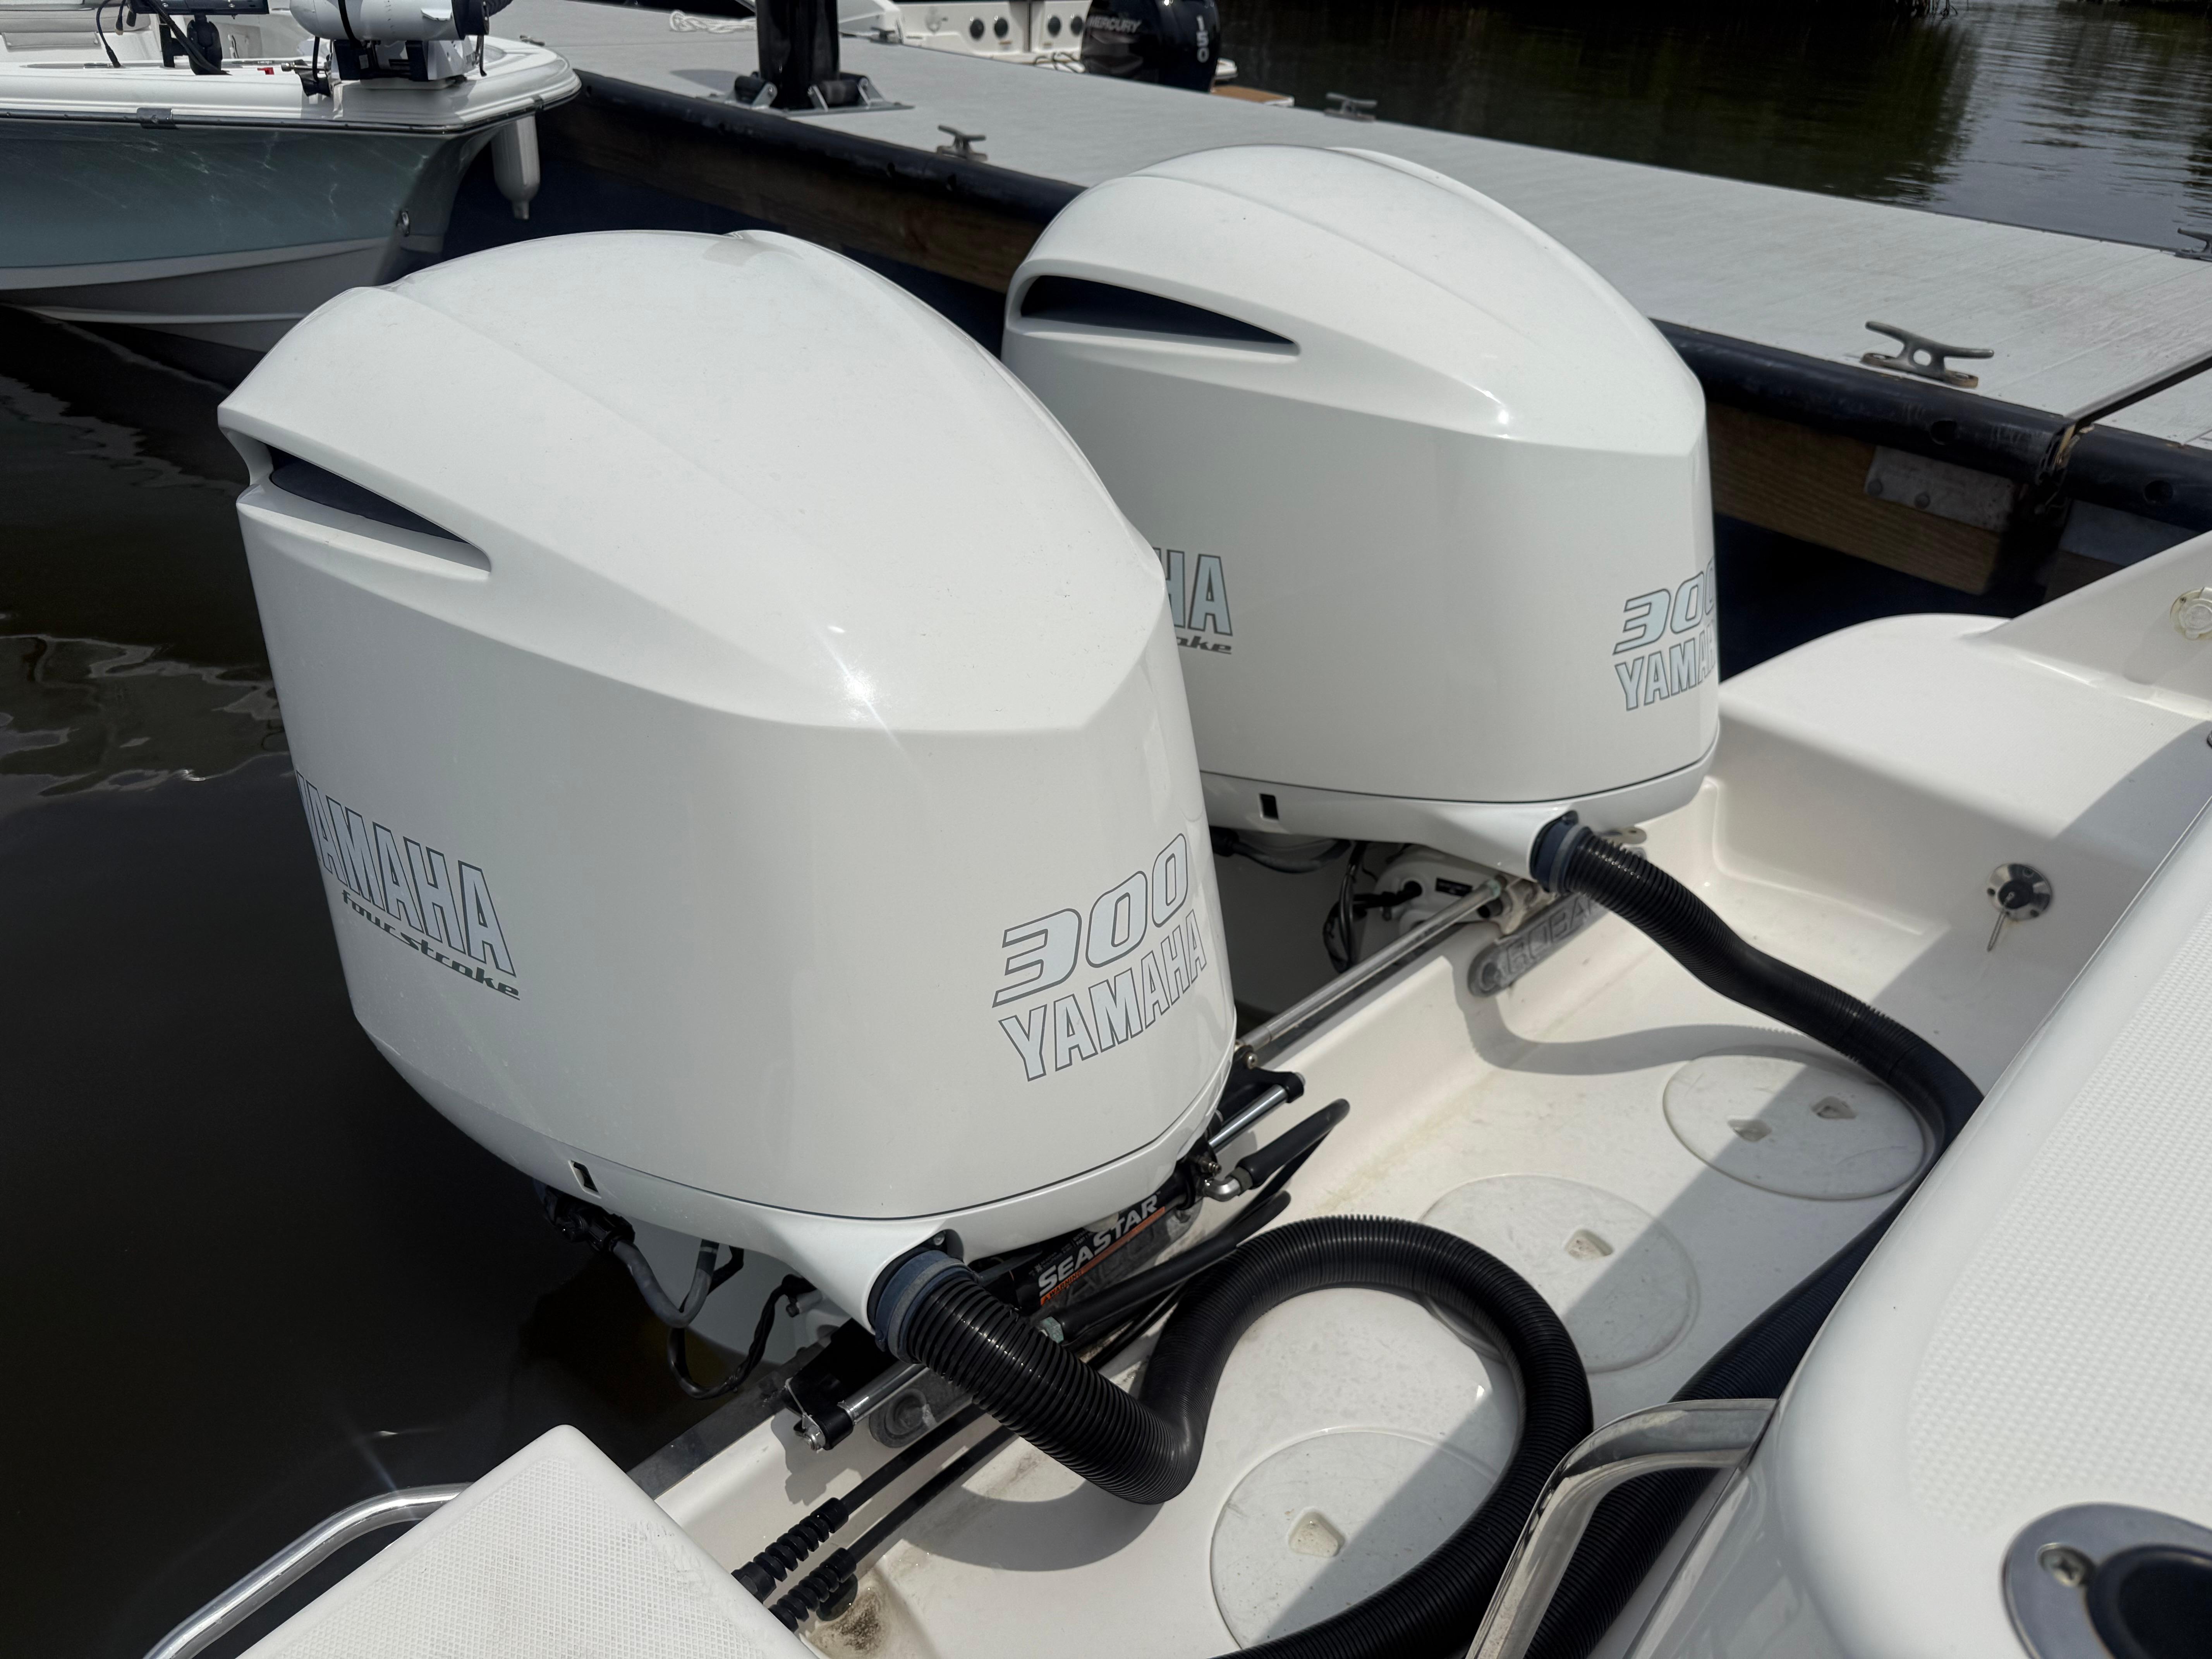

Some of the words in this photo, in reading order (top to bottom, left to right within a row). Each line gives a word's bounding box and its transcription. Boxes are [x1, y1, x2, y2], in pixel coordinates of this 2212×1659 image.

[1085, 14, 1142, 33] MERCURY
[1196, 15, 1210, 63] 150
[1614, 619, 1716, 711] YAMAH
[992, 833, 1188, 1008] 300
[998, 908, 1207, 1082] YAMAHA
